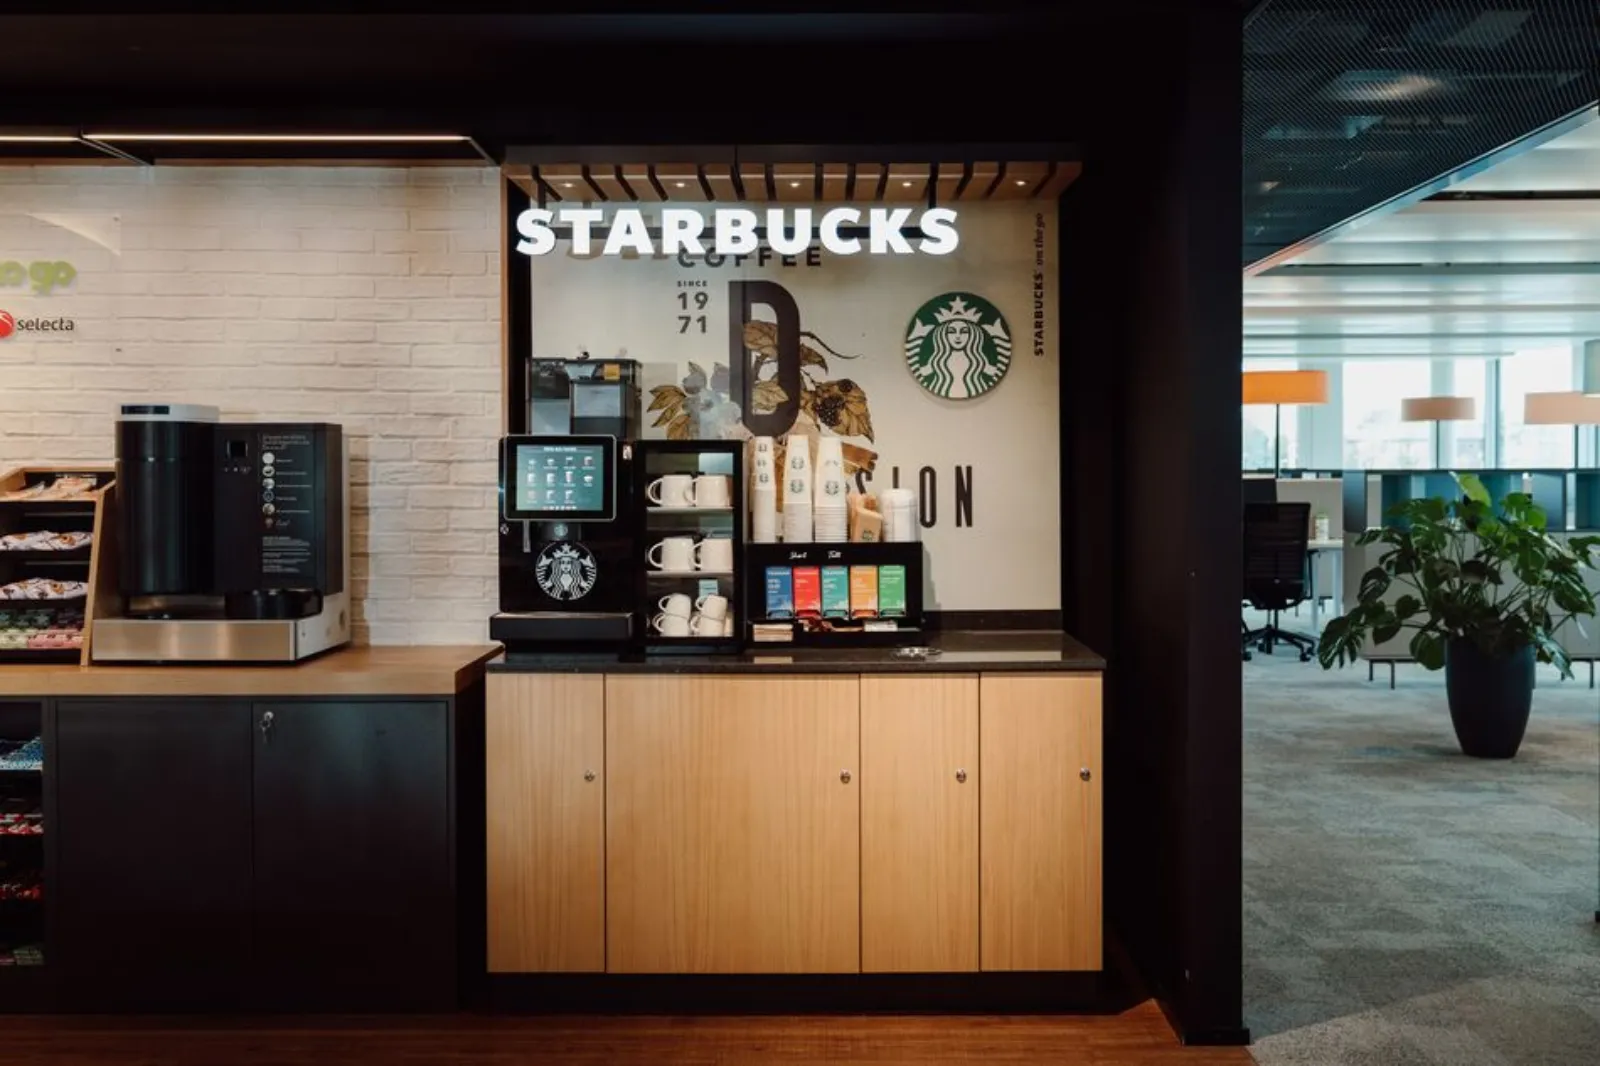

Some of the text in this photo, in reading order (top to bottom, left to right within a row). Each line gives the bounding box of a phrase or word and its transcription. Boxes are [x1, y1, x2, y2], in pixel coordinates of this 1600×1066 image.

[516, 208, 959, 255] STARBUCKS
[30, 261, 77, 296] go
[677, 292, 708, 310] 19
[1034, 272, 1044, 356] STARBUCKS
[17, 317, 75, 331] selecta
[678, 315, 707, 334] 71
